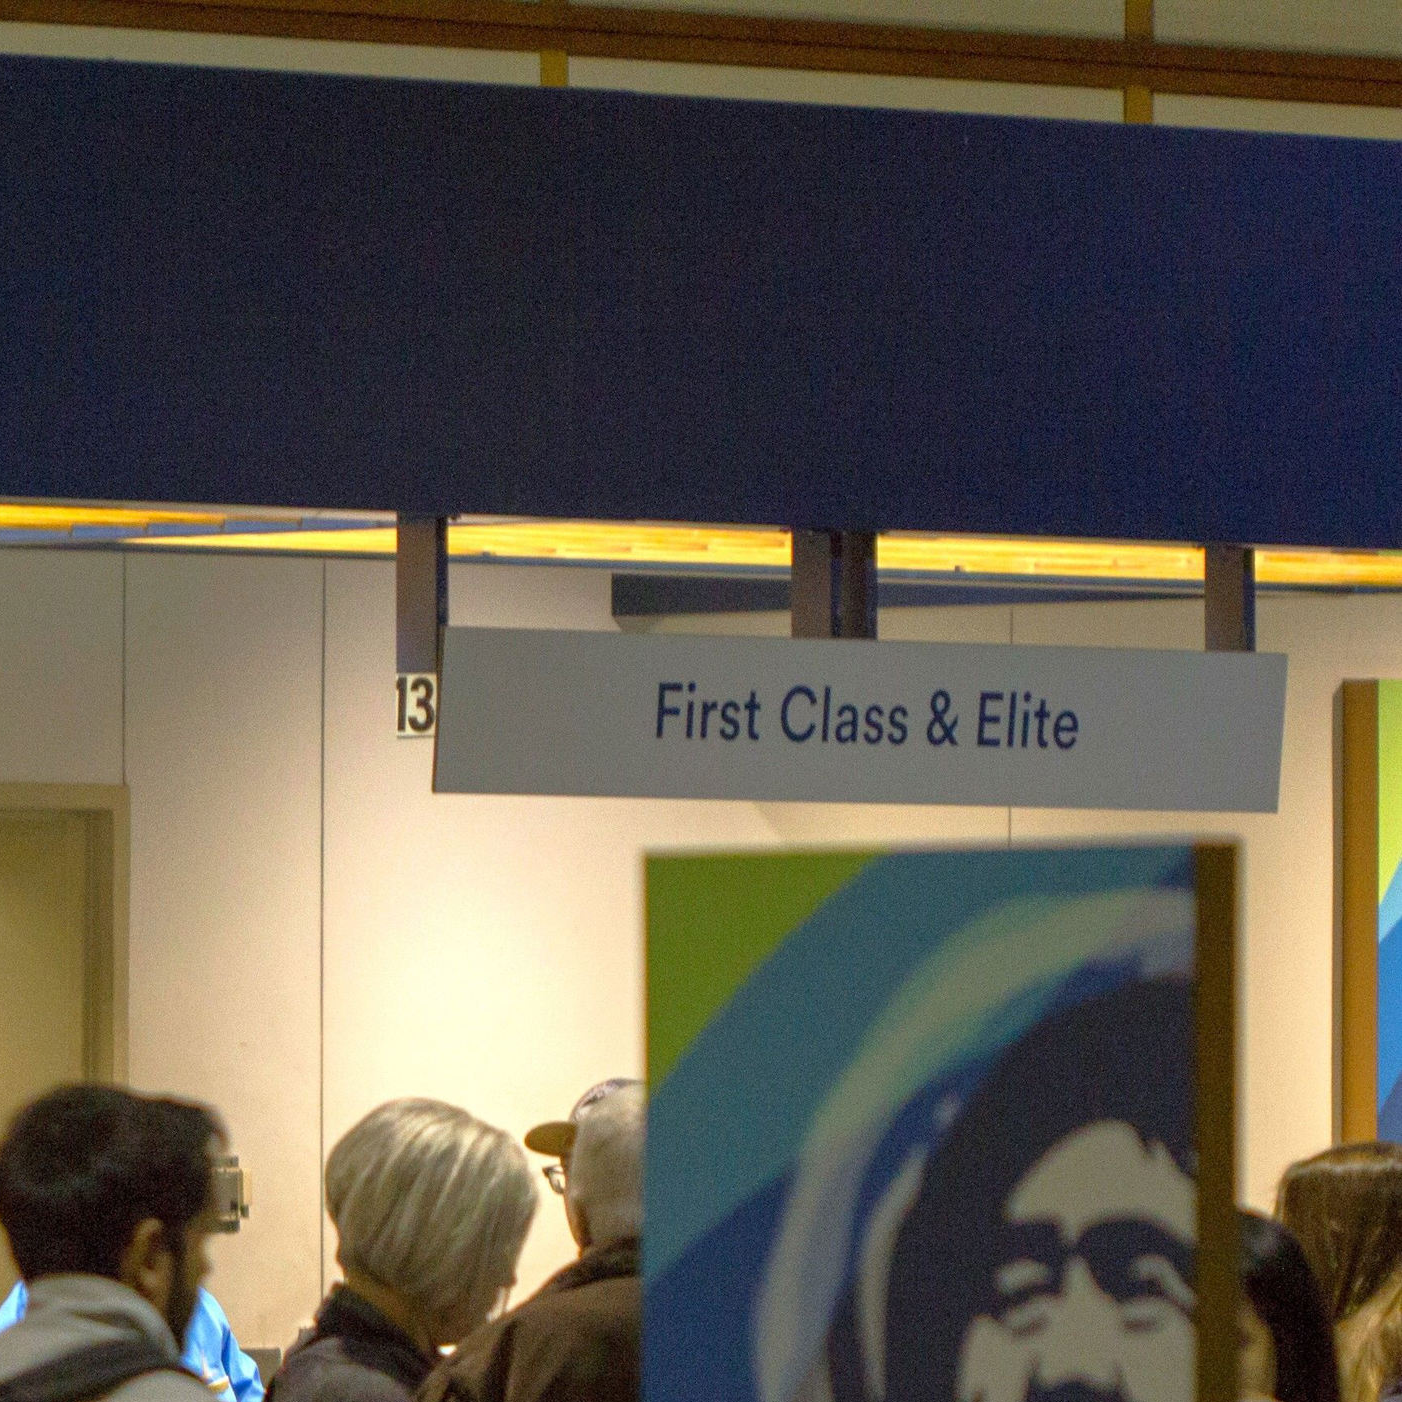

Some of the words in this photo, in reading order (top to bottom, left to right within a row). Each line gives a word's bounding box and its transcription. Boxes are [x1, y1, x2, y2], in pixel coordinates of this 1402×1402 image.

[396, 676, 435, 733] 13
[655, 681, 762, 742] First
[780, 684, 909, 746] Class
[926, 688, 959, 748] &
[976, 691, 1080, 751] Elite
